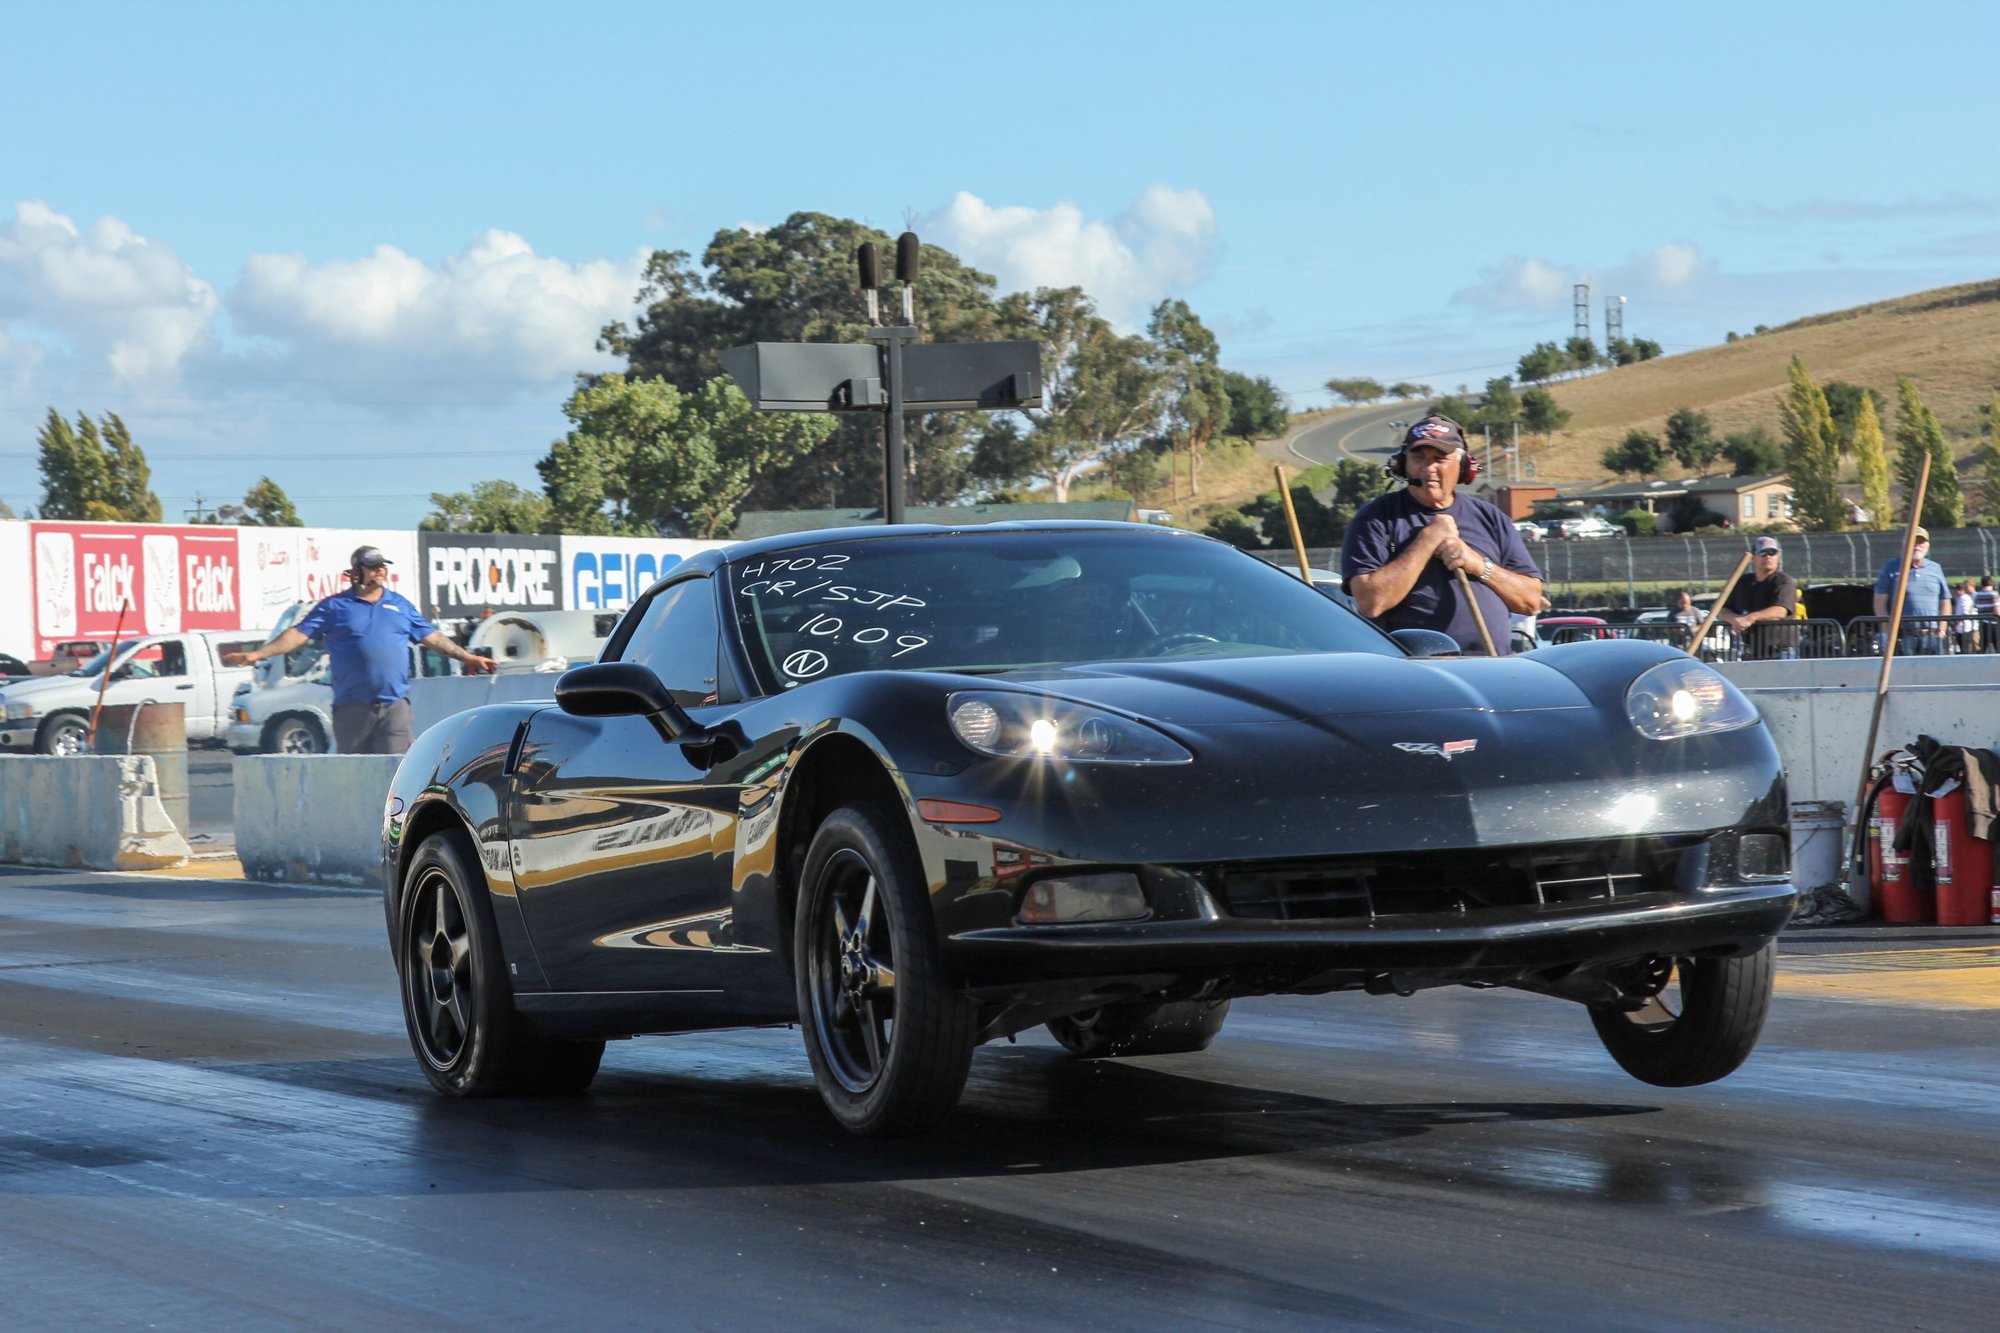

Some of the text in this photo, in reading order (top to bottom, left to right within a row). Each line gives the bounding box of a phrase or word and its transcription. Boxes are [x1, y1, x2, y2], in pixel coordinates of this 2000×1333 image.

[83, 553, 136, 612] Falck
[185, 554, 236, 612] Falck
[428, 547, 557, 605] PROCORE
[742, 554, 850, 577] H702
[797, 613, 928, 658] 10.09
